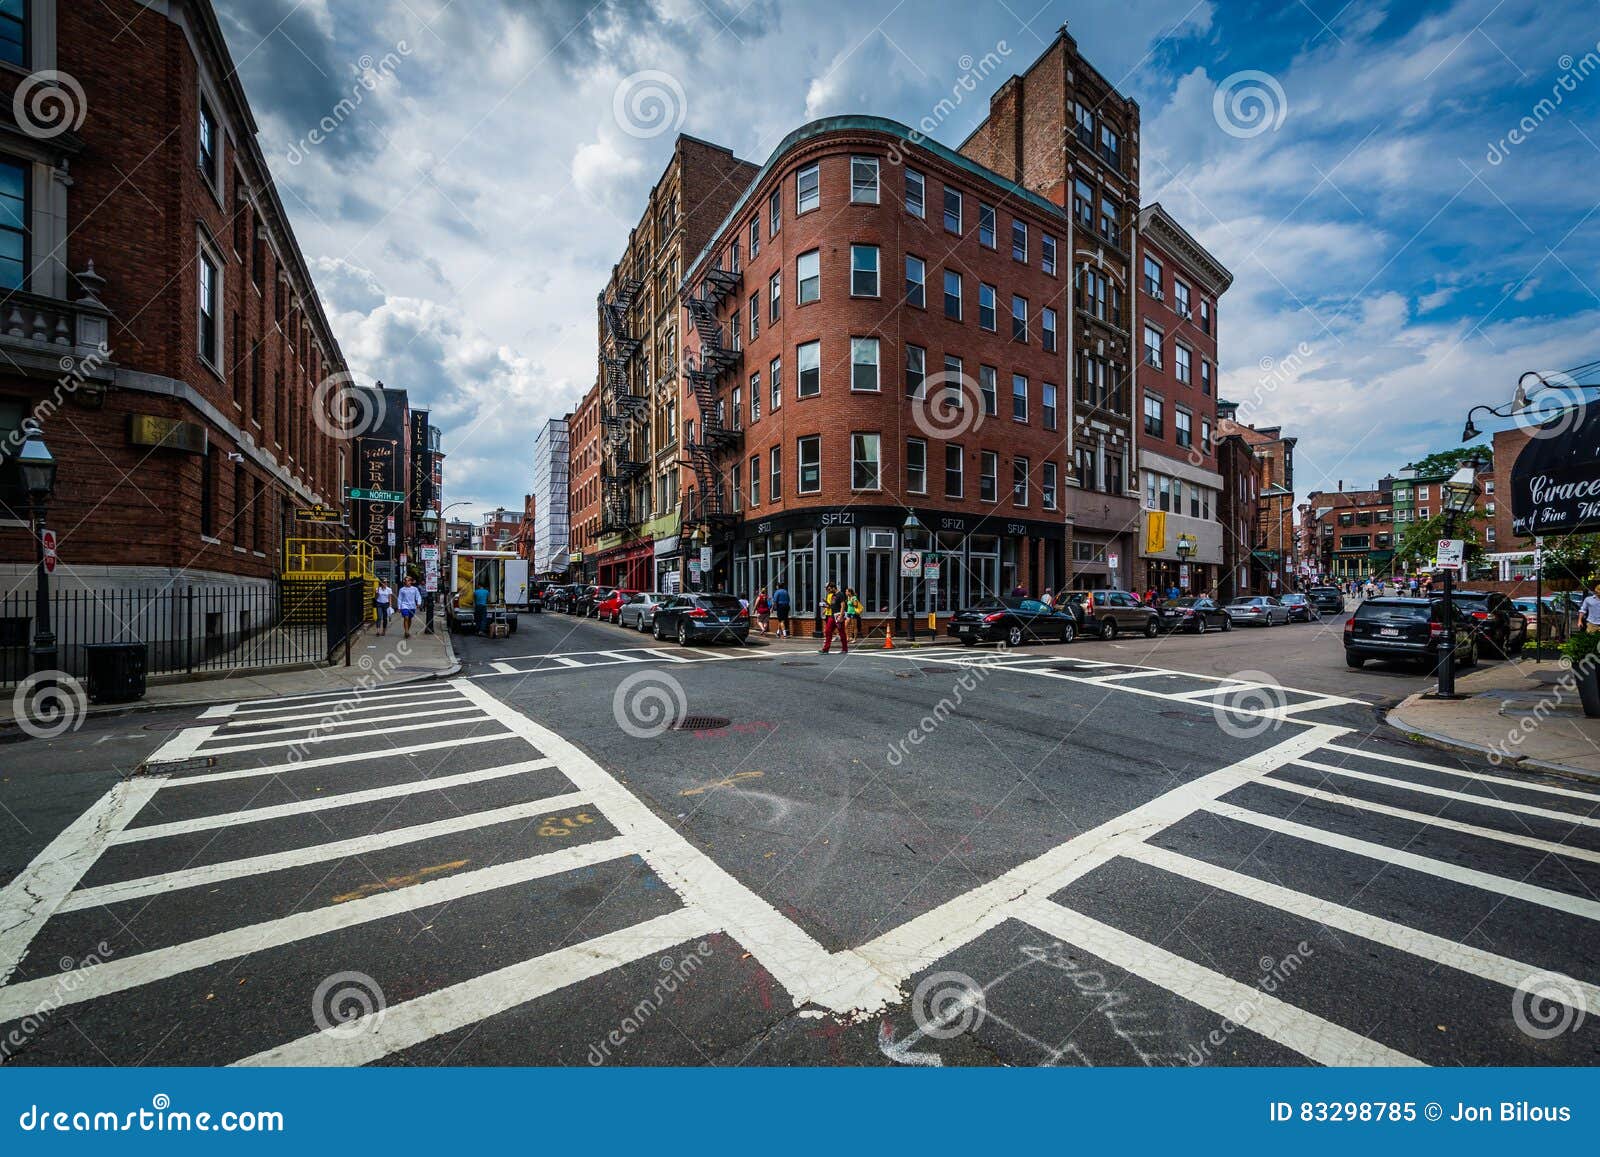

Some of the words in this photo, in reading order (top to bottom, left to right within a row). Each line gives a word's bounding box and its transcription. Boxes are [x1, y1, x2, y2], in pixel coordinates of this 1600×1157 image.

[369, 491, 392, 500] NORTH
[368, 461, 385, 556] FRACESCA
[821, 512, 855, 525] SFIZI
[1541, 507, 1567, 523] Fine
[941, 518, 964, 530] SFIZI
[1007, 523, 1027, 535] SFIZI
